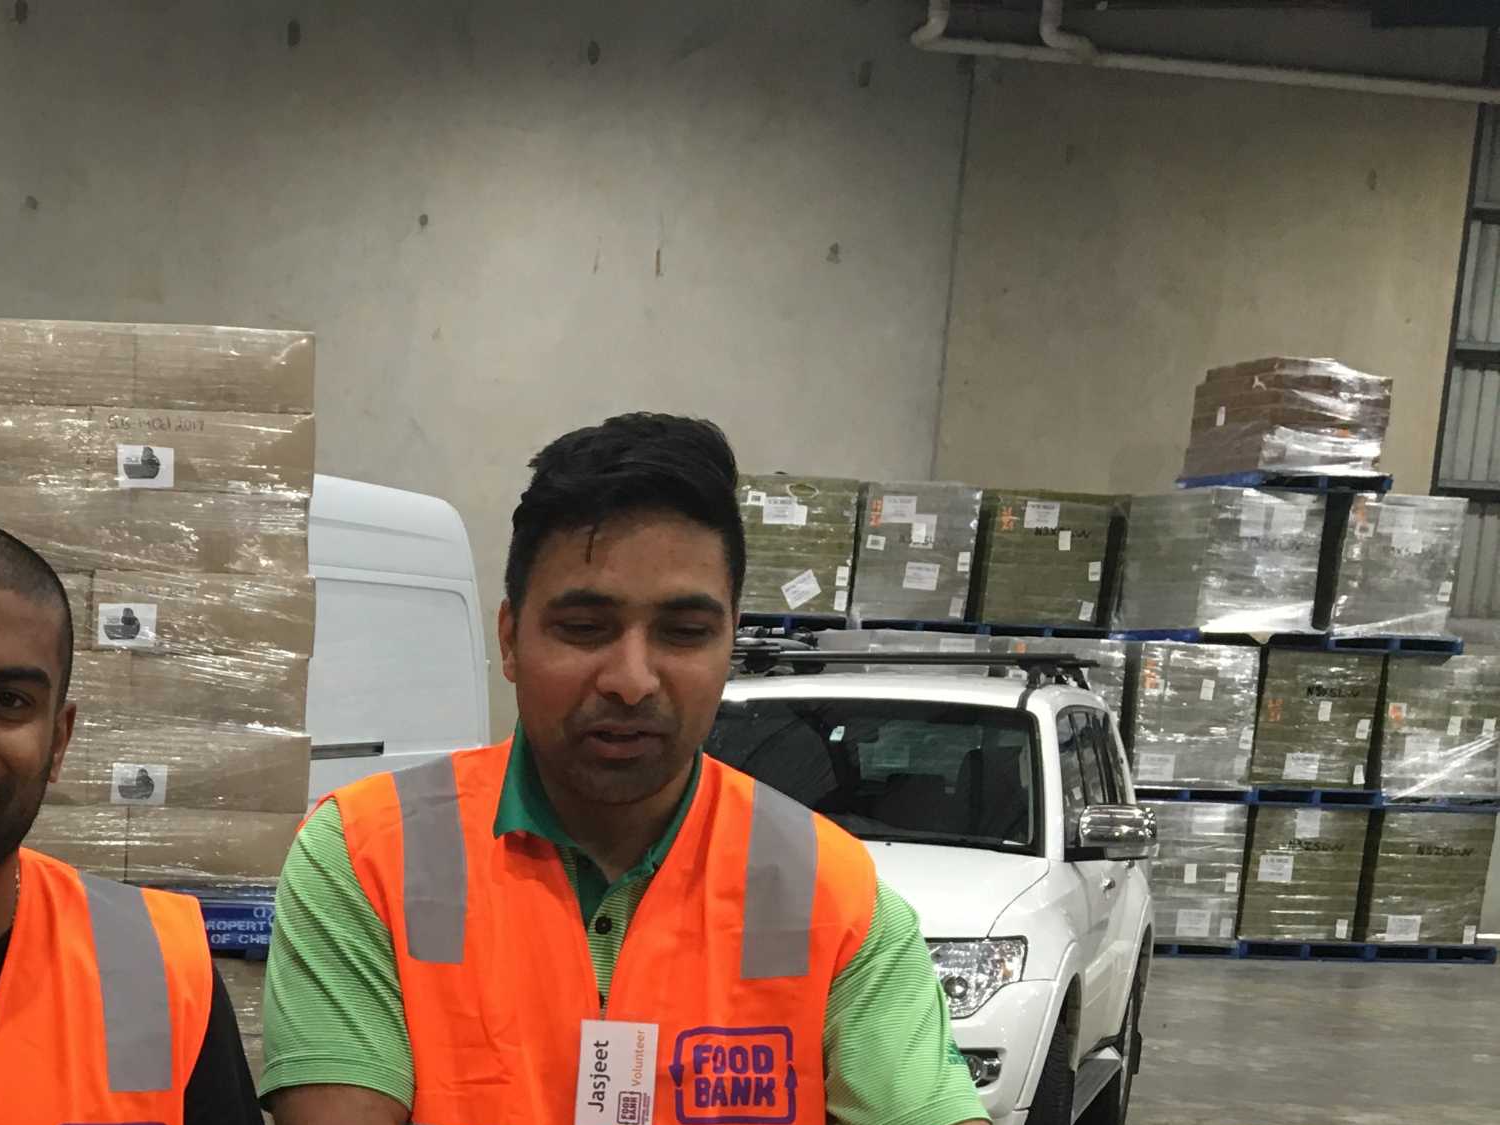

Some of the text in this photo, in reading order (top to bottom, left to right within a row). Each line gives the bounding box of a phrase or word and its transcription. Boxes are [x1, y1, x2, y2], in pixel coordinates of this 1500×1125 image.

[631, 1029, 644, 1086] Volunteer
[693, 1045, 775, 1074] FOOD
[587, 1039, 610, 1112] Jasjeet
[693, 1076, 776, 1108] BANK
[620, 1096, 629, 1119] FOOD
[628, 1096, 637, 1119] BANK
